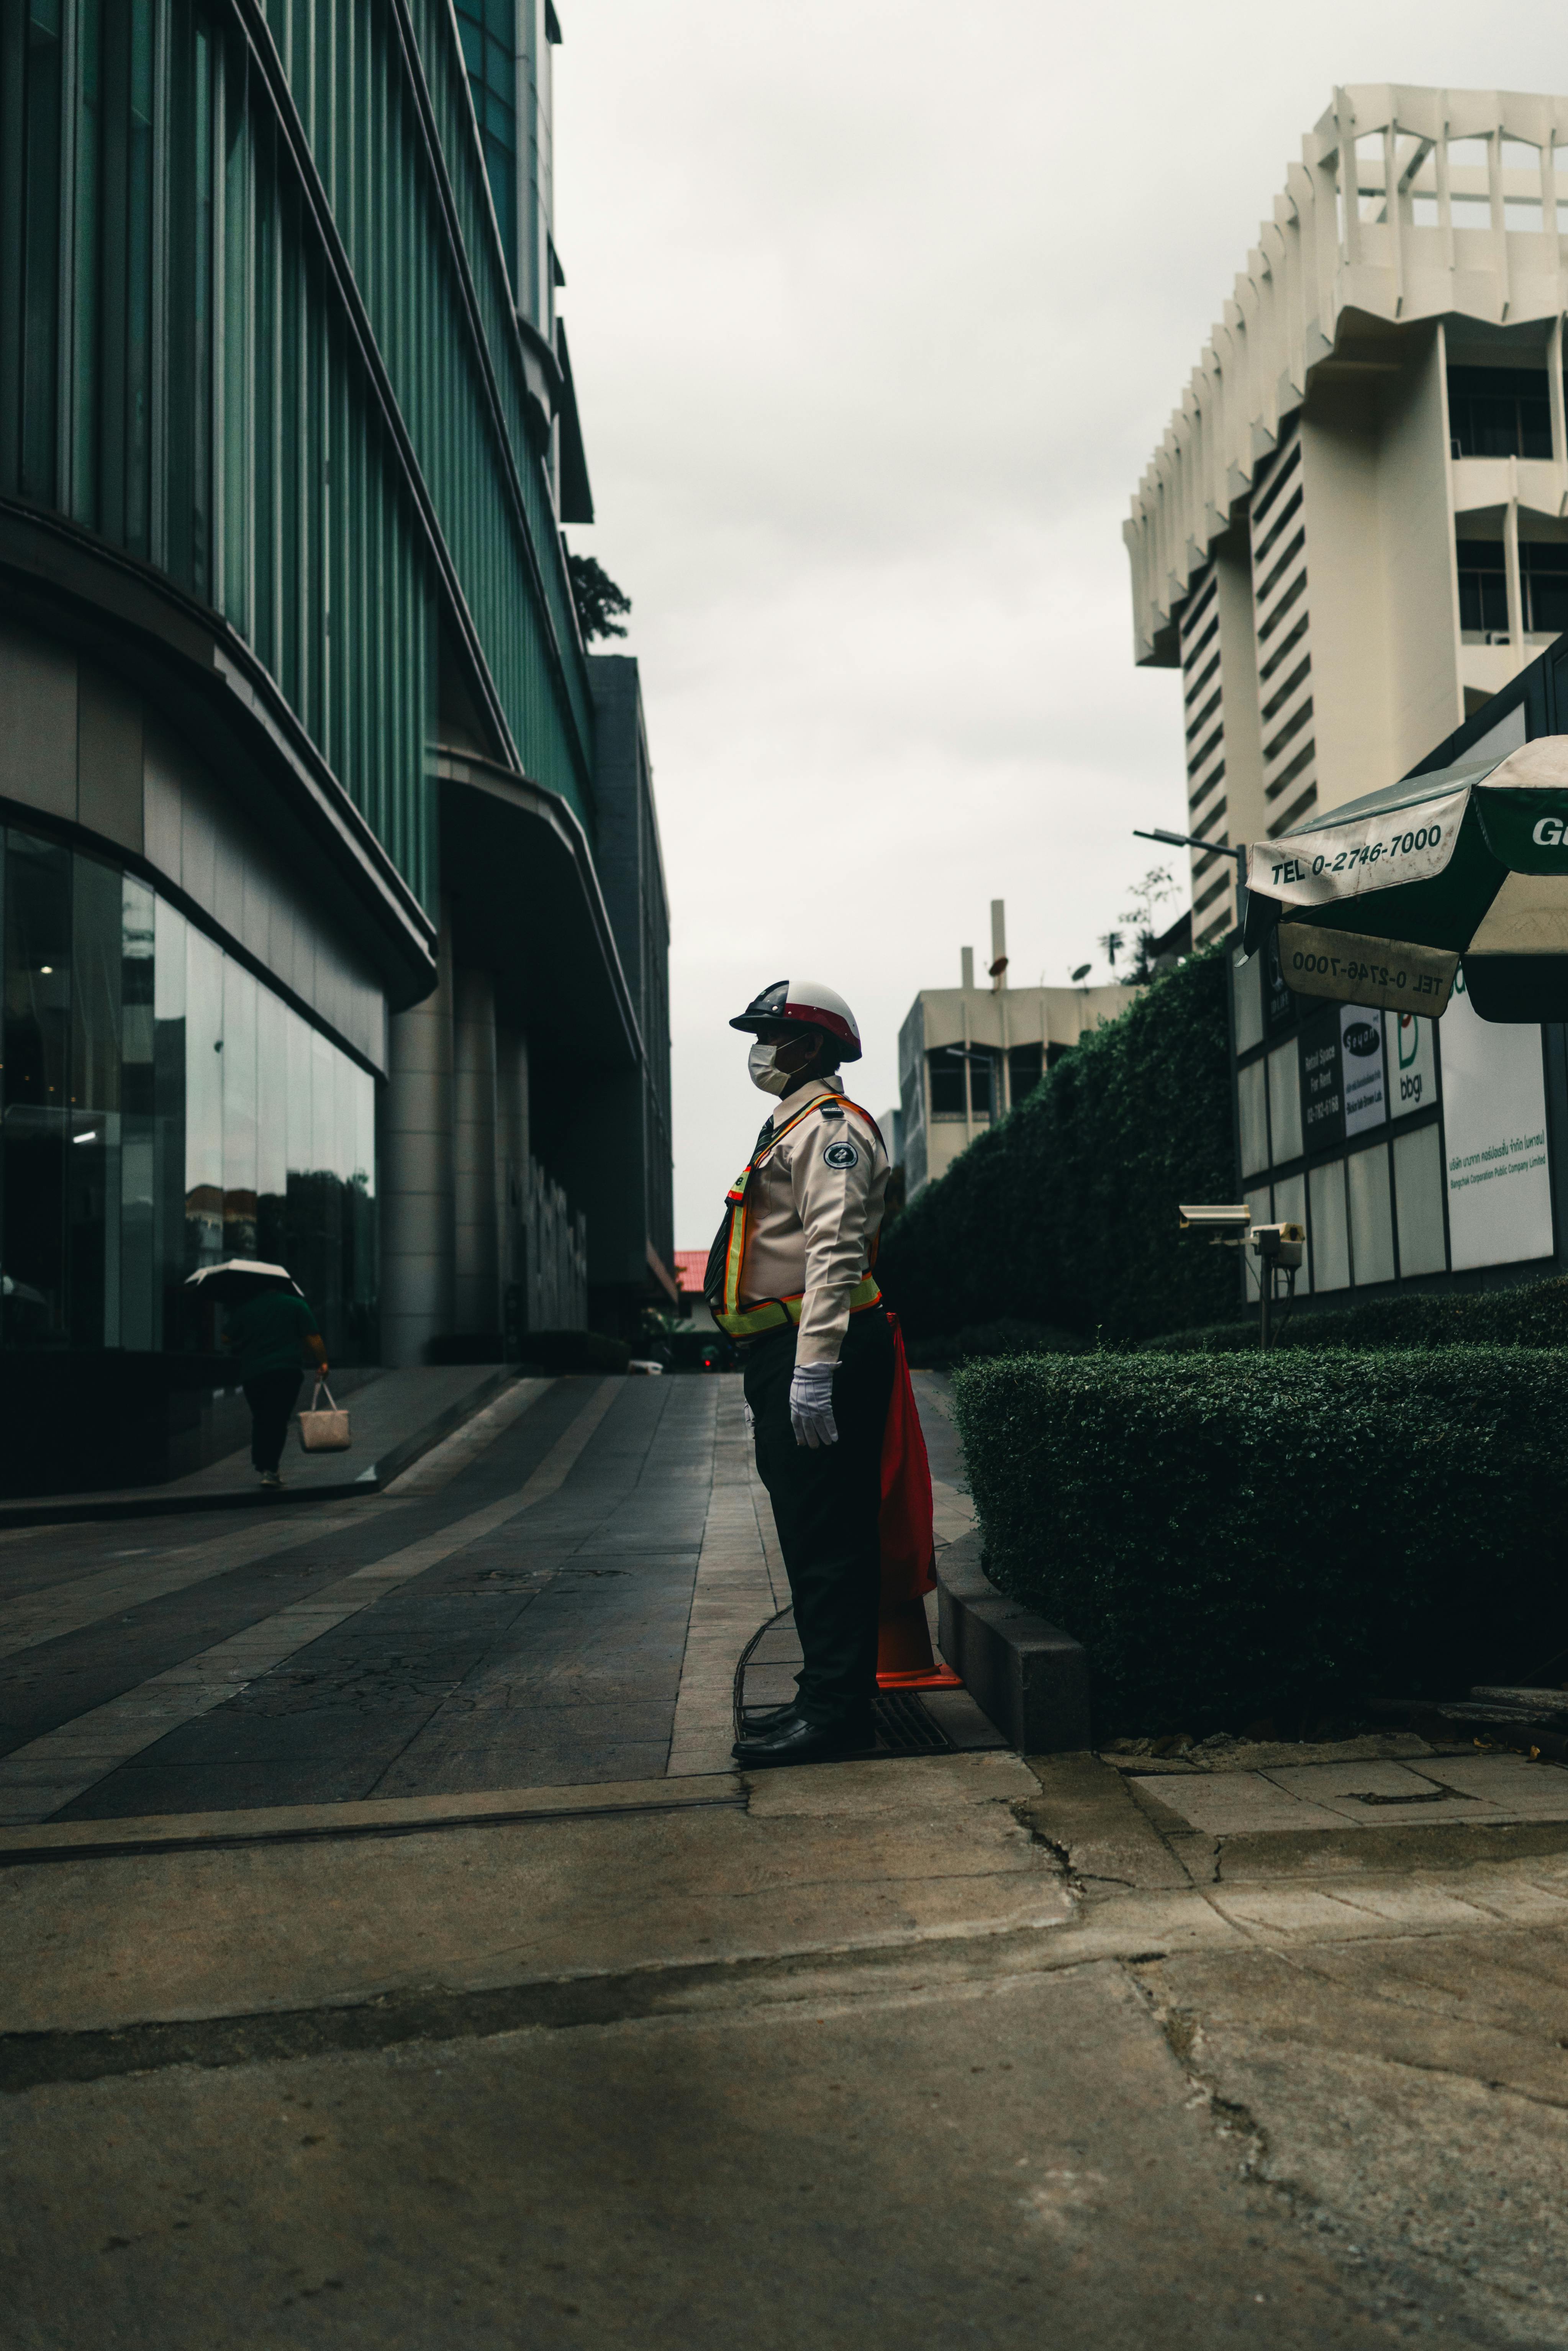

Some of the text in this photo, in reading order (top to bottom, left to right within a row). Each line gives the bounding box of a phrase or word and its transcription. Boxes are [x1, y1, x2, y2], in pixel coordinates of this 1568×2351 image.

[1271, 824, 1442, 885] TEL 0-2746-7000
[1450, 1153, 1546, 1190] Bangchak Corporation Public Company Limited
